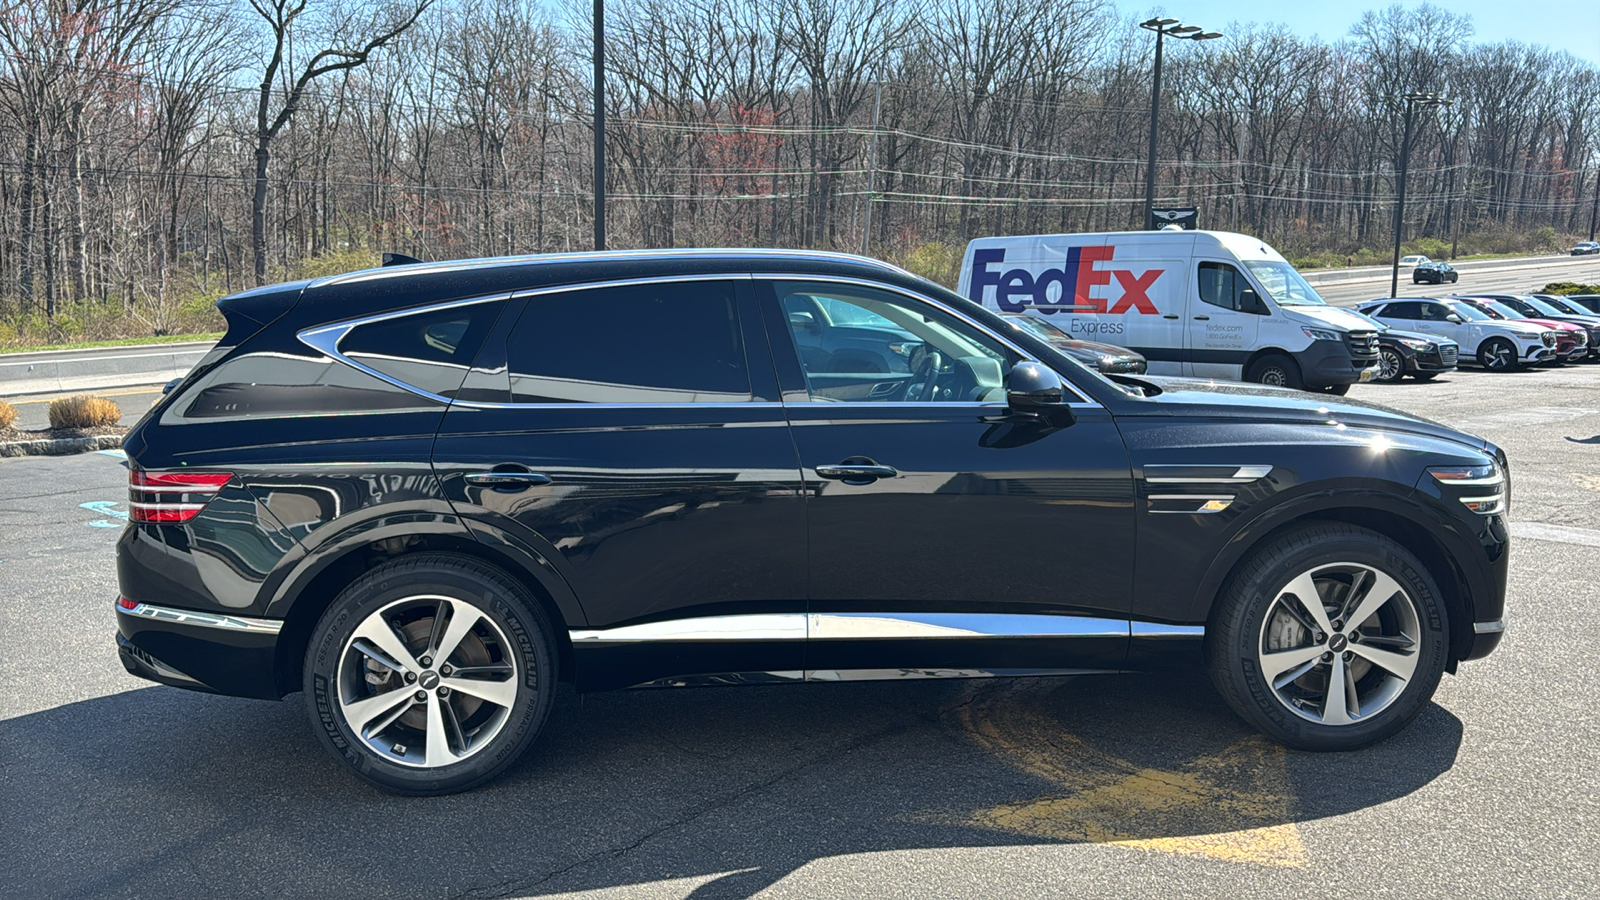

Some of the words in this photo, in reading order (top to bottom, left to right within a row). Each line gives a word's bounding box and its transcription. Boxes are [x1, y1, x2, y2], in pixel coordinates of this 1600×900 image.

[969, 245, 1166, 315] FedEx
[1070, 318, 1124, 336] Express
[1206, 323, 1243, 332] fedex.com
[1253, 597, 1261, 610] 20
[1403, 566, 1441, 631] MICHELIN
[317, 632, 334, 667] 265/50
[332, 625, 339, 634] R
[338, 612, 348, 626] 20
[506, 616, 538, 690] MICHELIN
[1429, 640, 1442, 680] PRIMACY
[315, 678, 348, 749] MICHELIN
[1243, 660, 1282, 723] MICHELIN
[513, 698, 535, 739] PRIMACY
[496, 739, 516, 761] TOUR
